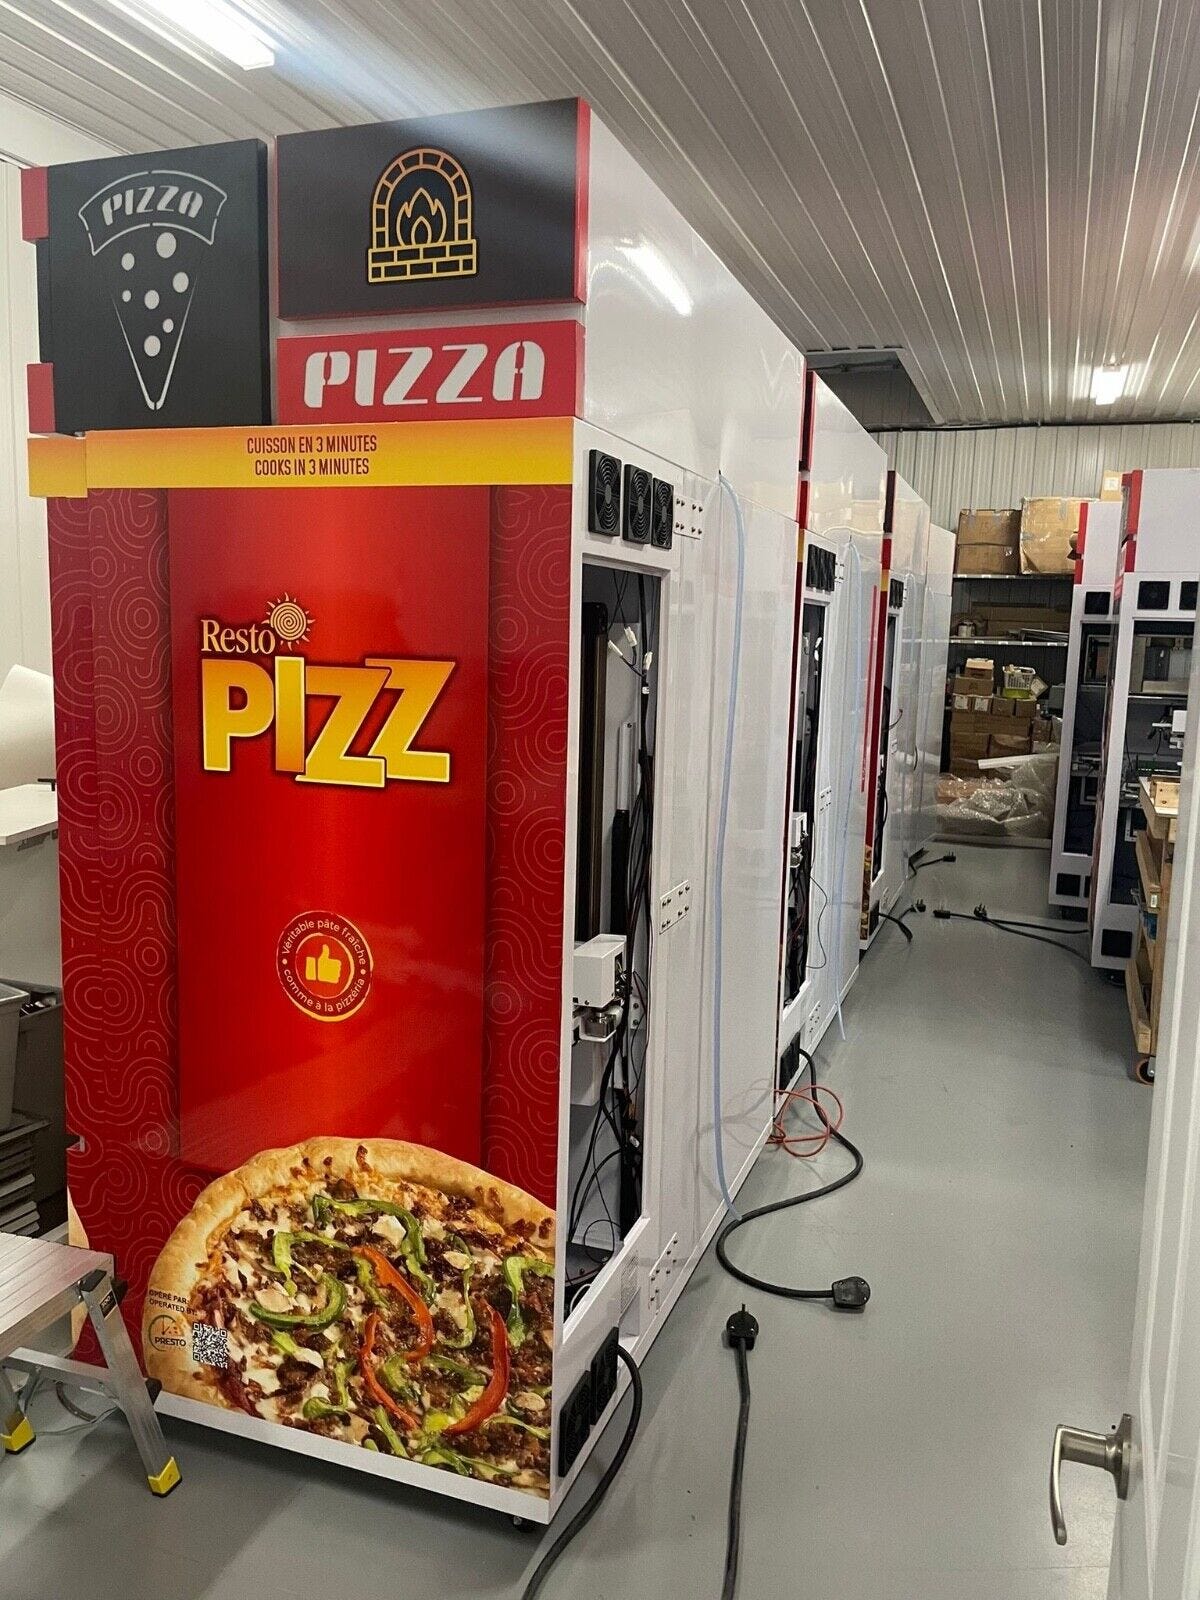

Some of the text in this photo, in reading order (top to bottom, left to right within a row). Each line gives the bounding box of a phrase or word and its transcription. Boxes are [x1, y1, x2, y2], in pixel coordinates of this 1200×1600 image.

[102, 186, 203, 226] PIZZA
[304, 341, 545, 408] PIZZA
[247, 435, 377, 454] CUISSON EN 3 MINUTES
[255, 458, 369, 476] COOKS IN 3 MINUTES
[201, 619, 276, 655] Resto
[202, 655, 456, 788] PIZZ
[282, 919, 366, 965] Véritable pâte fraîche
[284, 969, 313, 1007] comme
[315, 1001, 322, 1010] à
[324, 1003, 334, 1012] la
[149, 1298, 185, 1313] OPERATED
[154, 1336, 187, 1347] PRESTO
